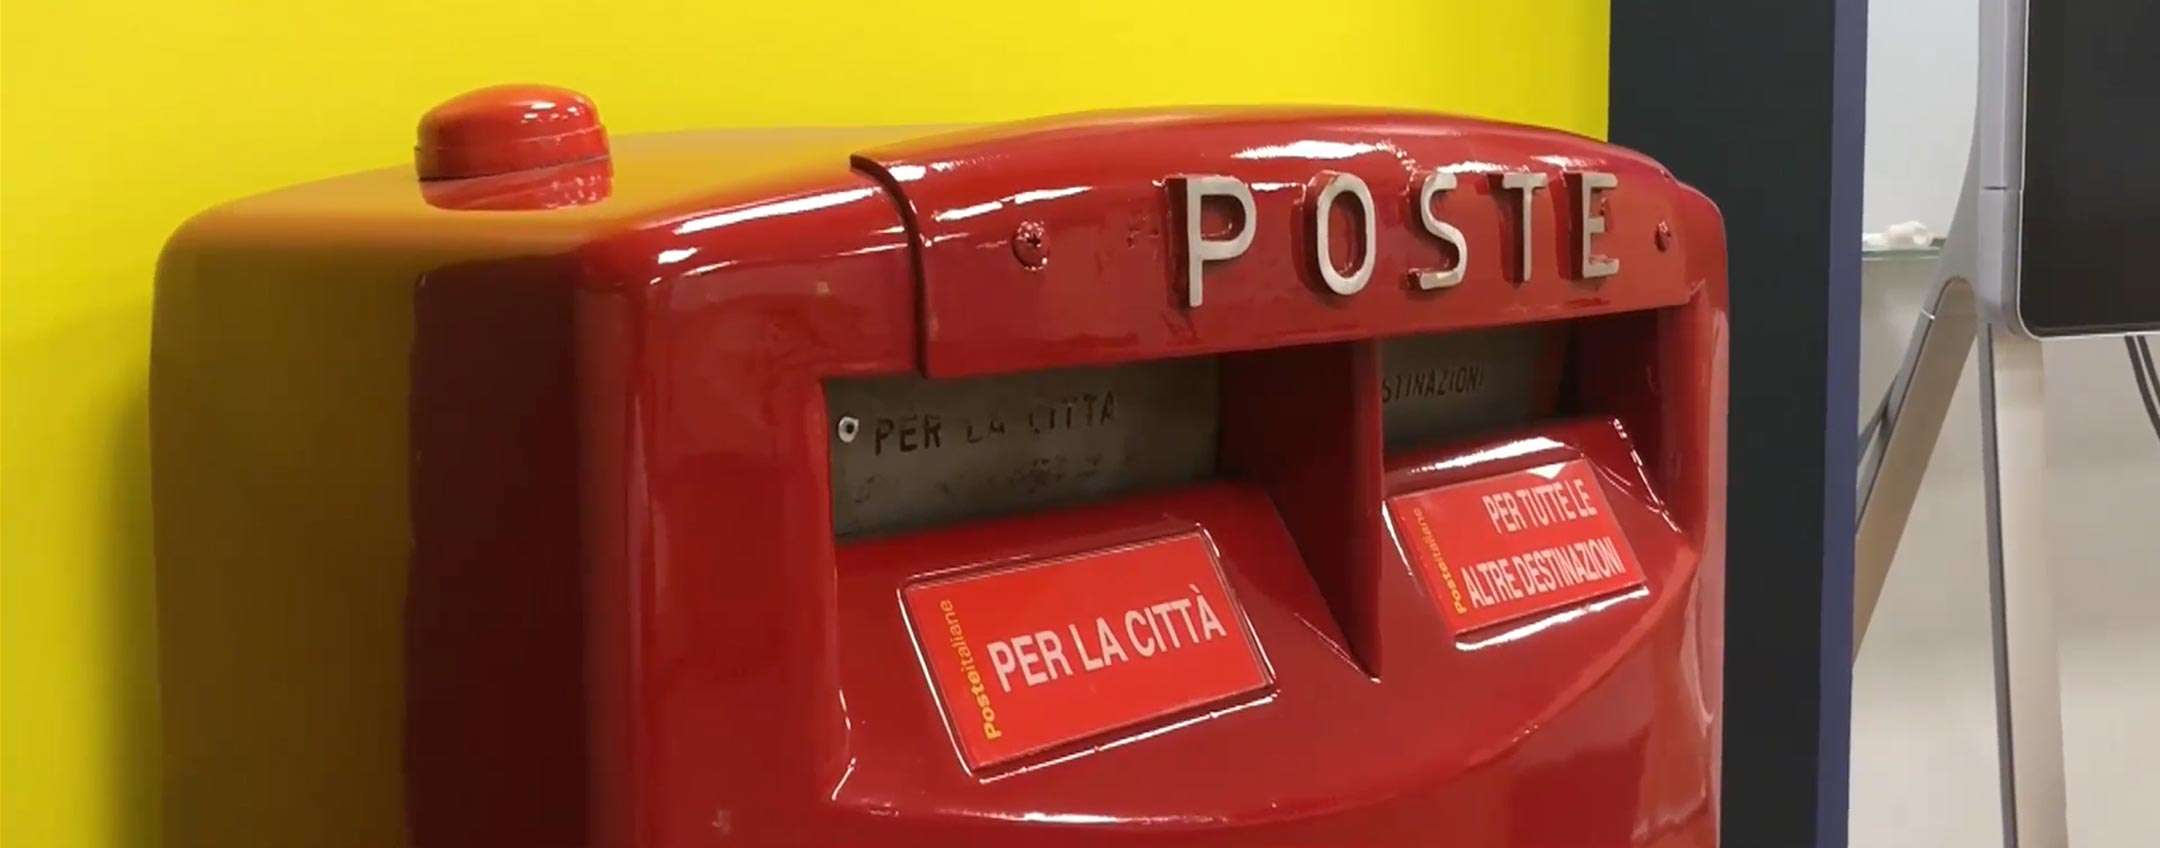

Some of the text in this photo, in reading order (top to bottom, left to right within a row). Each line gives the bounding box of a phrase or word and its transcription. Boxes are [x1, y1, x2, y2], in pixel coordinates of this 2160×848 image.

[1180, 170, 1621, 308] POSTE
[875, 415, 943, 456] PER
[1482, 479, 1598, 534] PER TUTTE LE
[1460, 536, 1627, 609] ALTRE DESTINAZIONI
[987, 583, 1227, 693] PER LA CITTÀ
